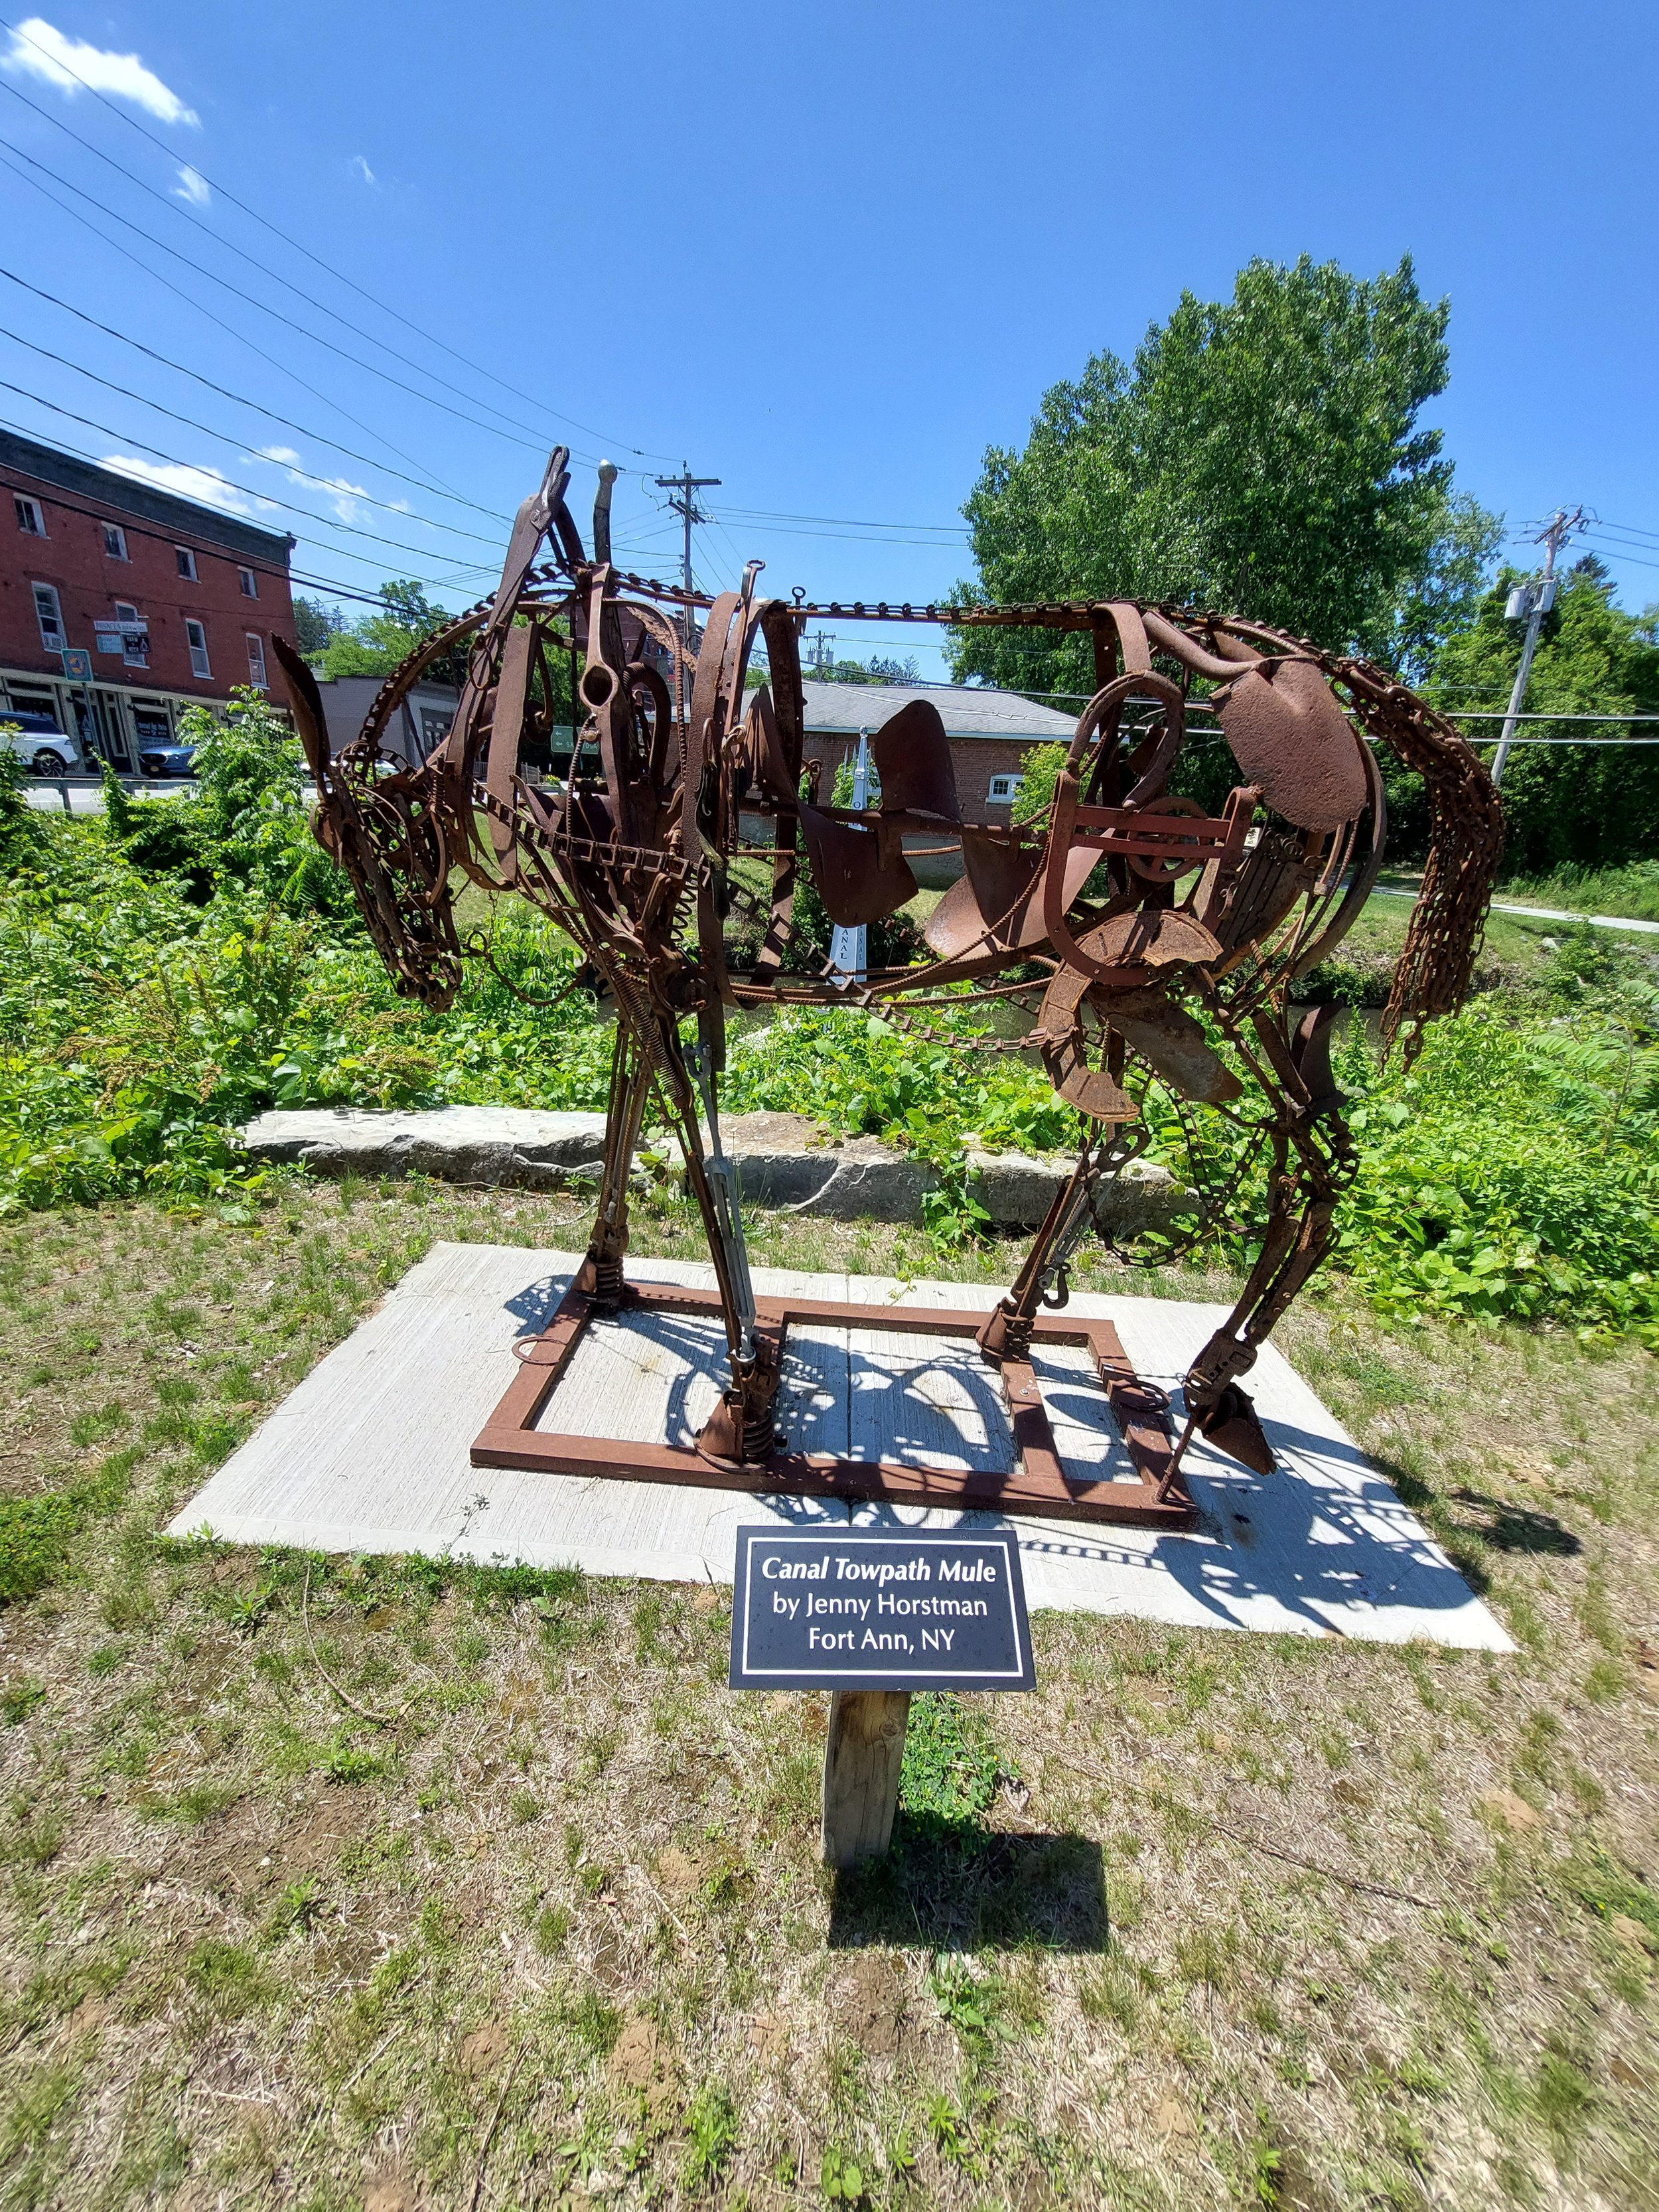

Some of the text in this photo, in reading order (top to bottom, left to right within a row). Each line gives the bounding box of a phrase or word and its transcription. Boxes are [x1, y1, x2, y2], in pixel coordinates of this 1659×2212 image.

[839, 928, 849, 960] ANAL
[762, 1556, 996, 1587] Canal Towpath Mule
[773, 1591, 987, 1621] by Jenny Horstman
[809, 1627, 956, 1655] Fort Ann, NY
